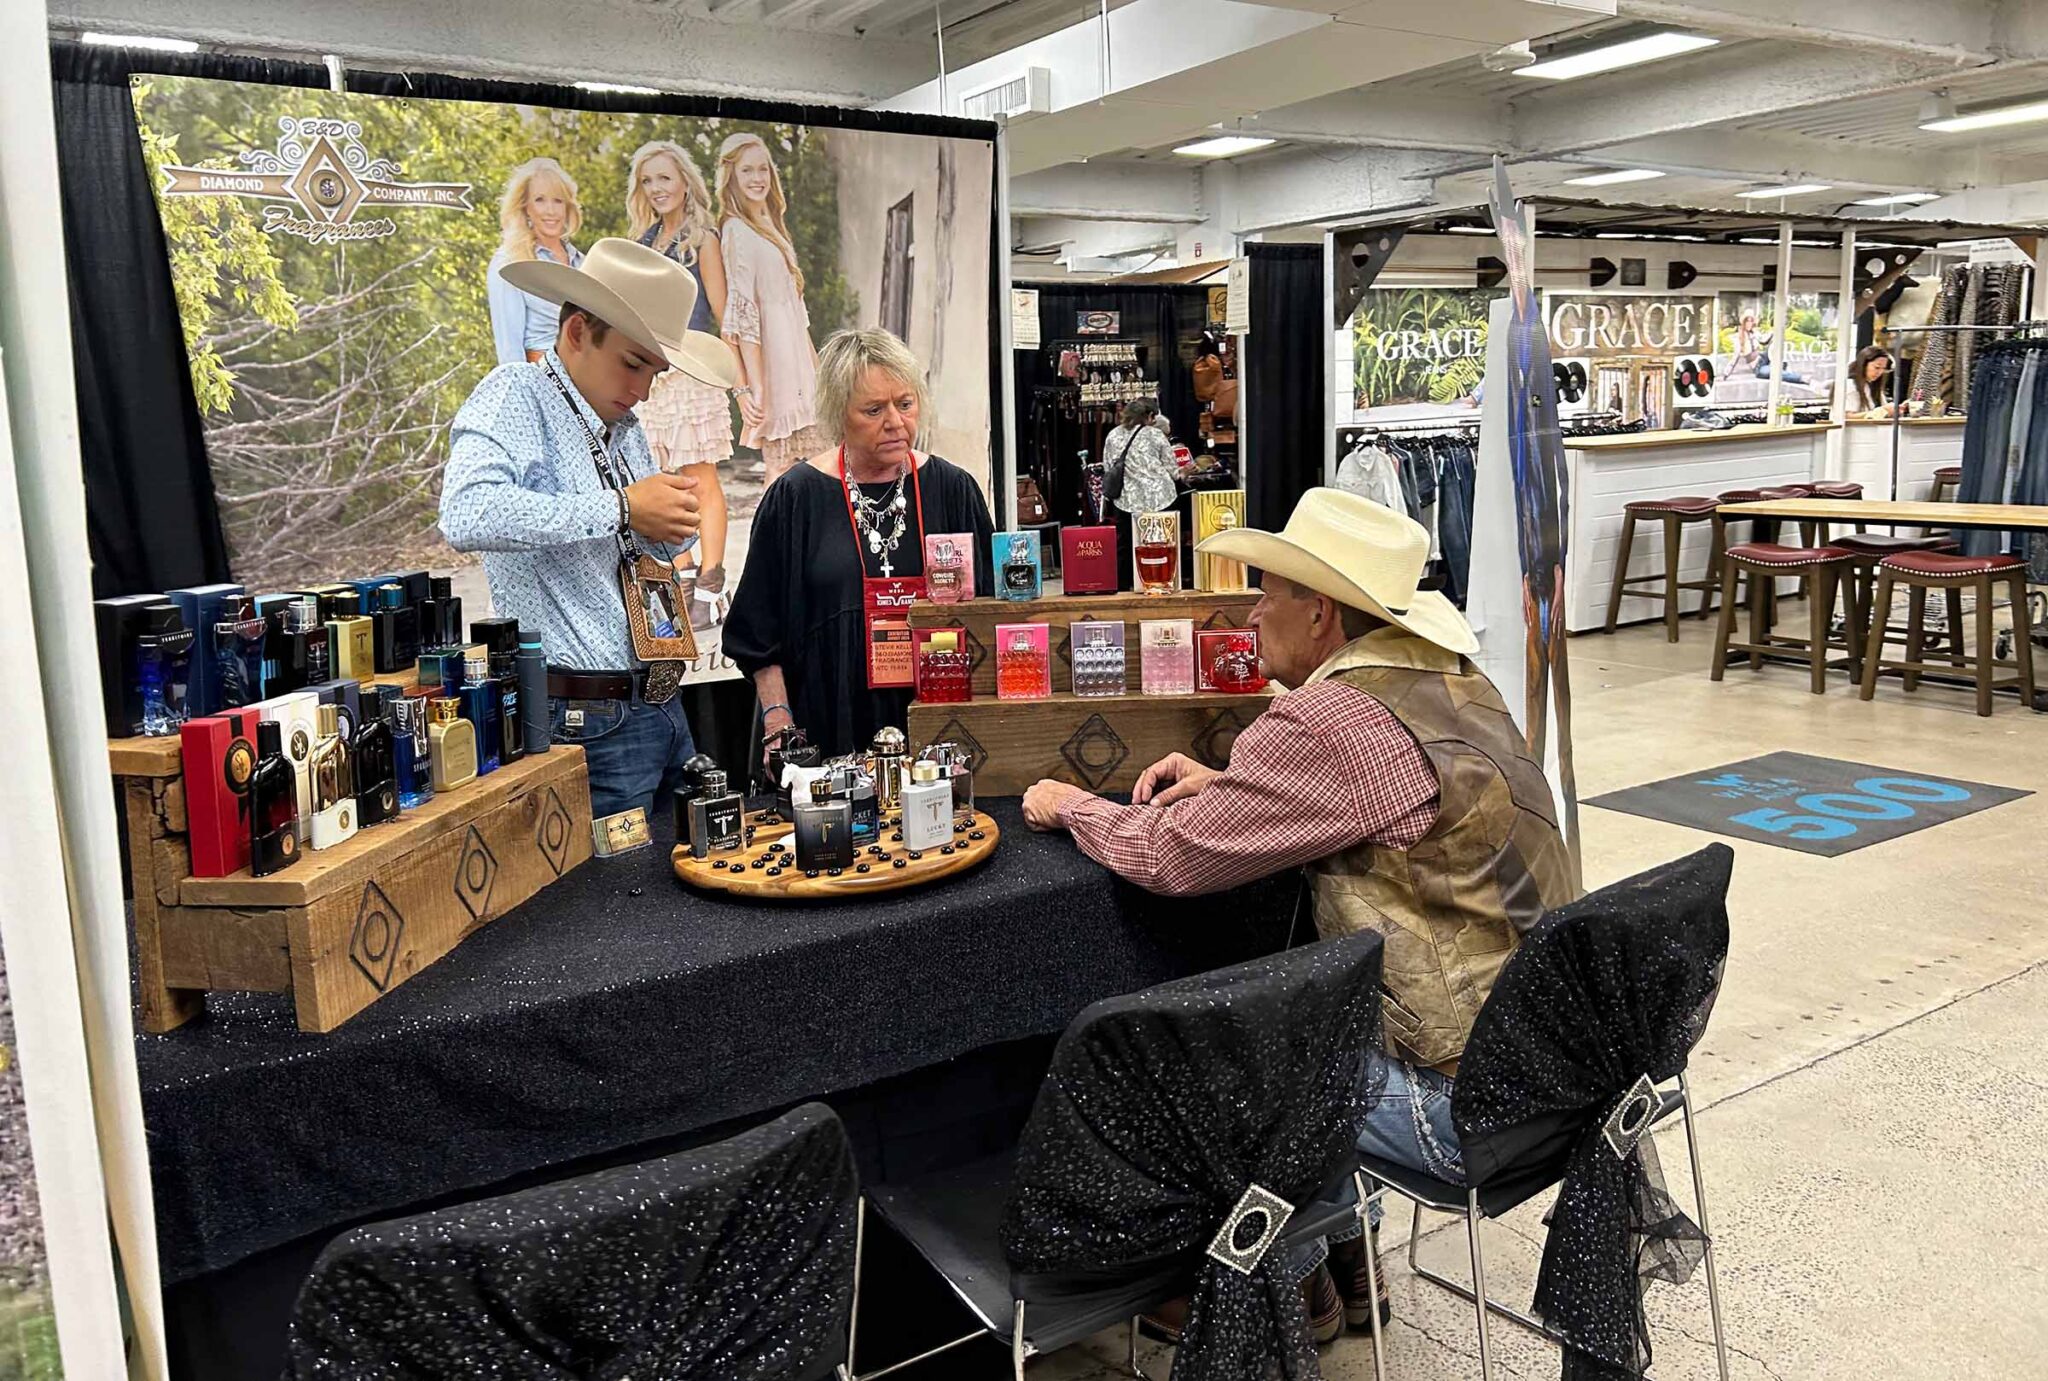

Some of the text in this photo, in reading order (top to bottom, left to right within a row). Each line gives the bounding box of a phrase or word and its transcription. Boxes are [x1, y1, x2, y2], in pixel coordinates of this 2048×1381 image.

[302, 121, 344, 136] B&D
[200, 176, 457, 202] DIAMOND COMPANY, INC.
[265, 208, 394, 243] Fragrances
[1552, 302, 1696, 350] GRACE
[1377, 328, 1482, 361] GRACE
[1769, 338, 1833, 362] RACE
[575, 413, 600, 452] COWBOY
[1077, 541, 1102, 550] ACQUA
[1727, 777, 1972, 840] 500
